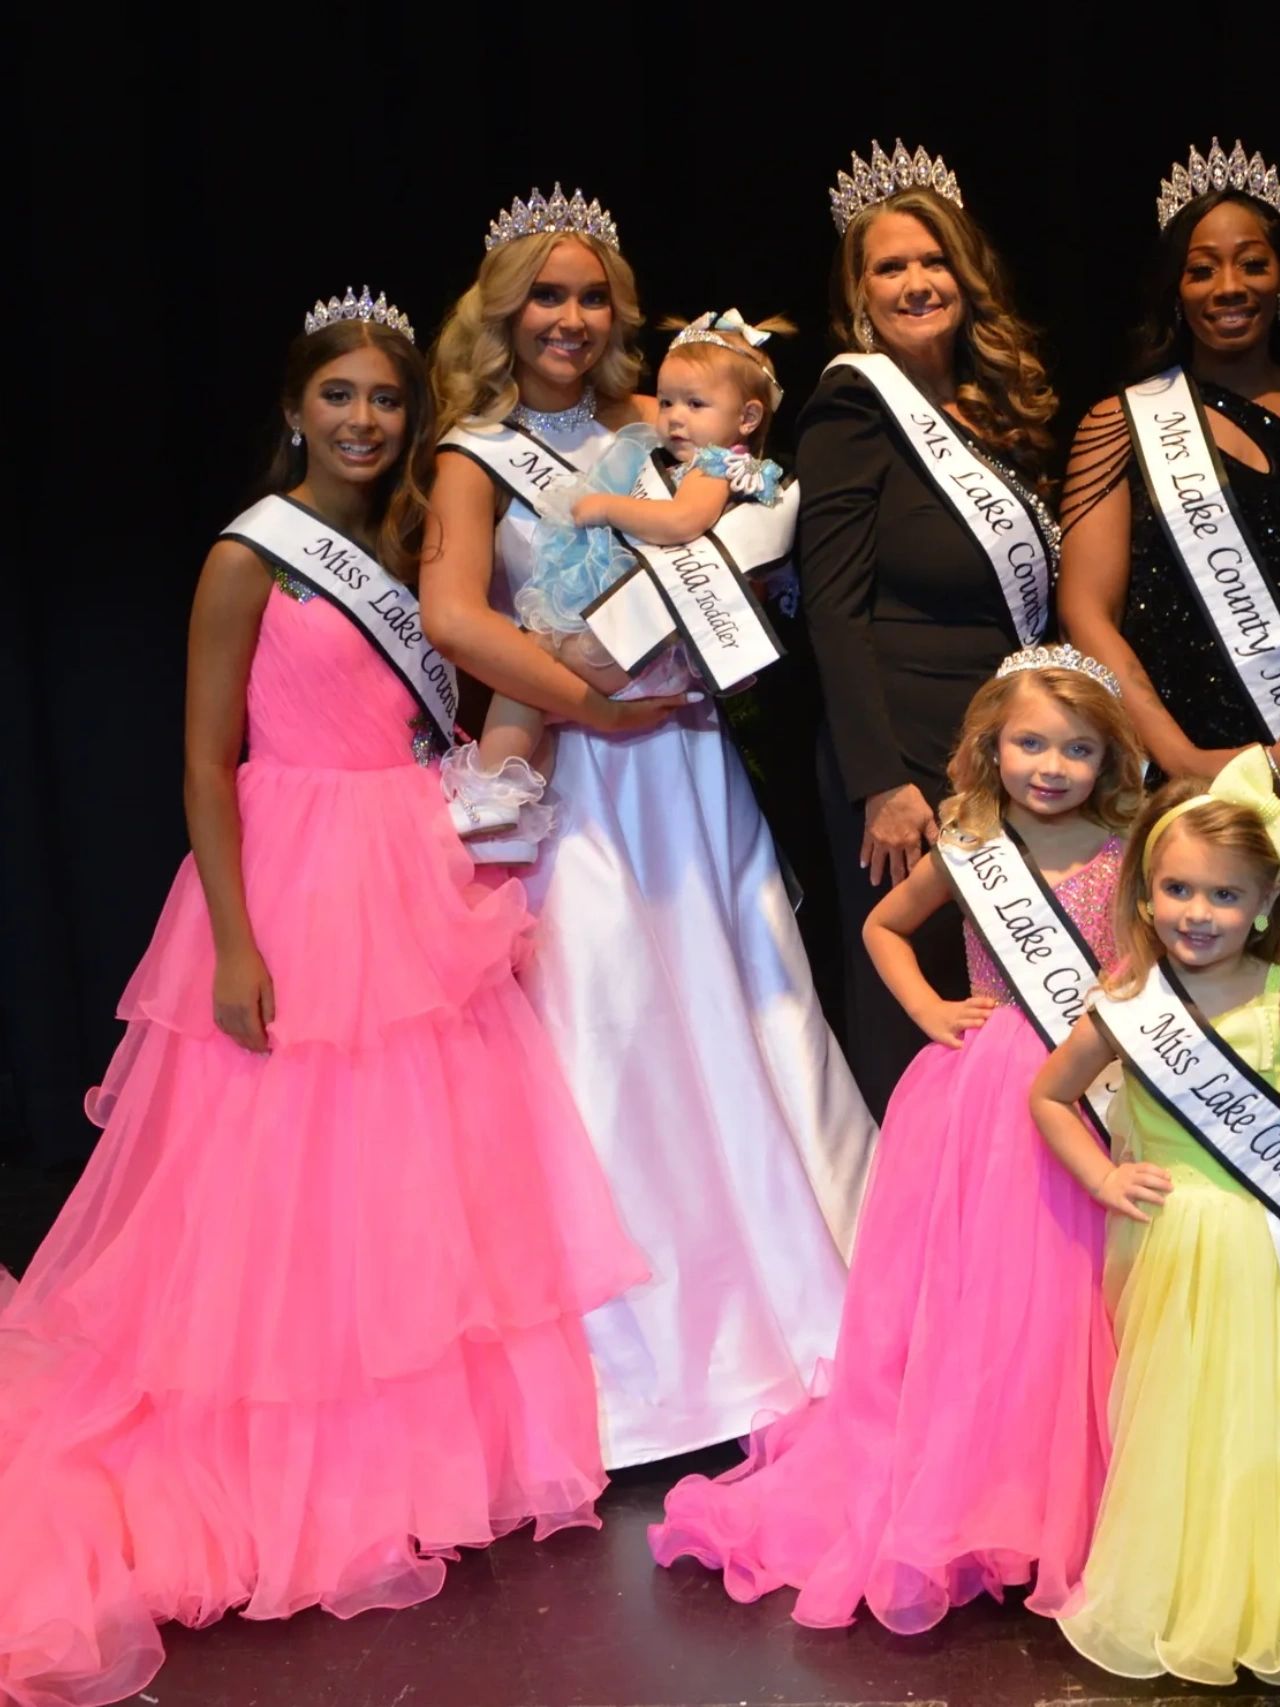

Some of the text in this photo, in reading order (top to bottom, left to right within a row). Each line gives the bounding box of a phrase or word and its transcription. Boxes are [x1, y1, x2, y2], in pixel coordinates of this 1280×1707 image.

[508, 452, 552, 491] Mi
[1153, 411, 1191, 462] Mrs
[910, 412, 1048, 645] Ms Lake County
[1171, 472, 1218, 540] Lake
[303, 538, 458, 720] Miss Lake Count
[660, 543, 741, 650] rida Toddler
[1207, 546, 1274, 657] County
[992, 897, 1058, 965] Lake
[1042, 966, 1087, 1027] Cou
[1140, 1012, 1201, 1077] Miss
[1189, 1073, 1257, 1135] Lake
